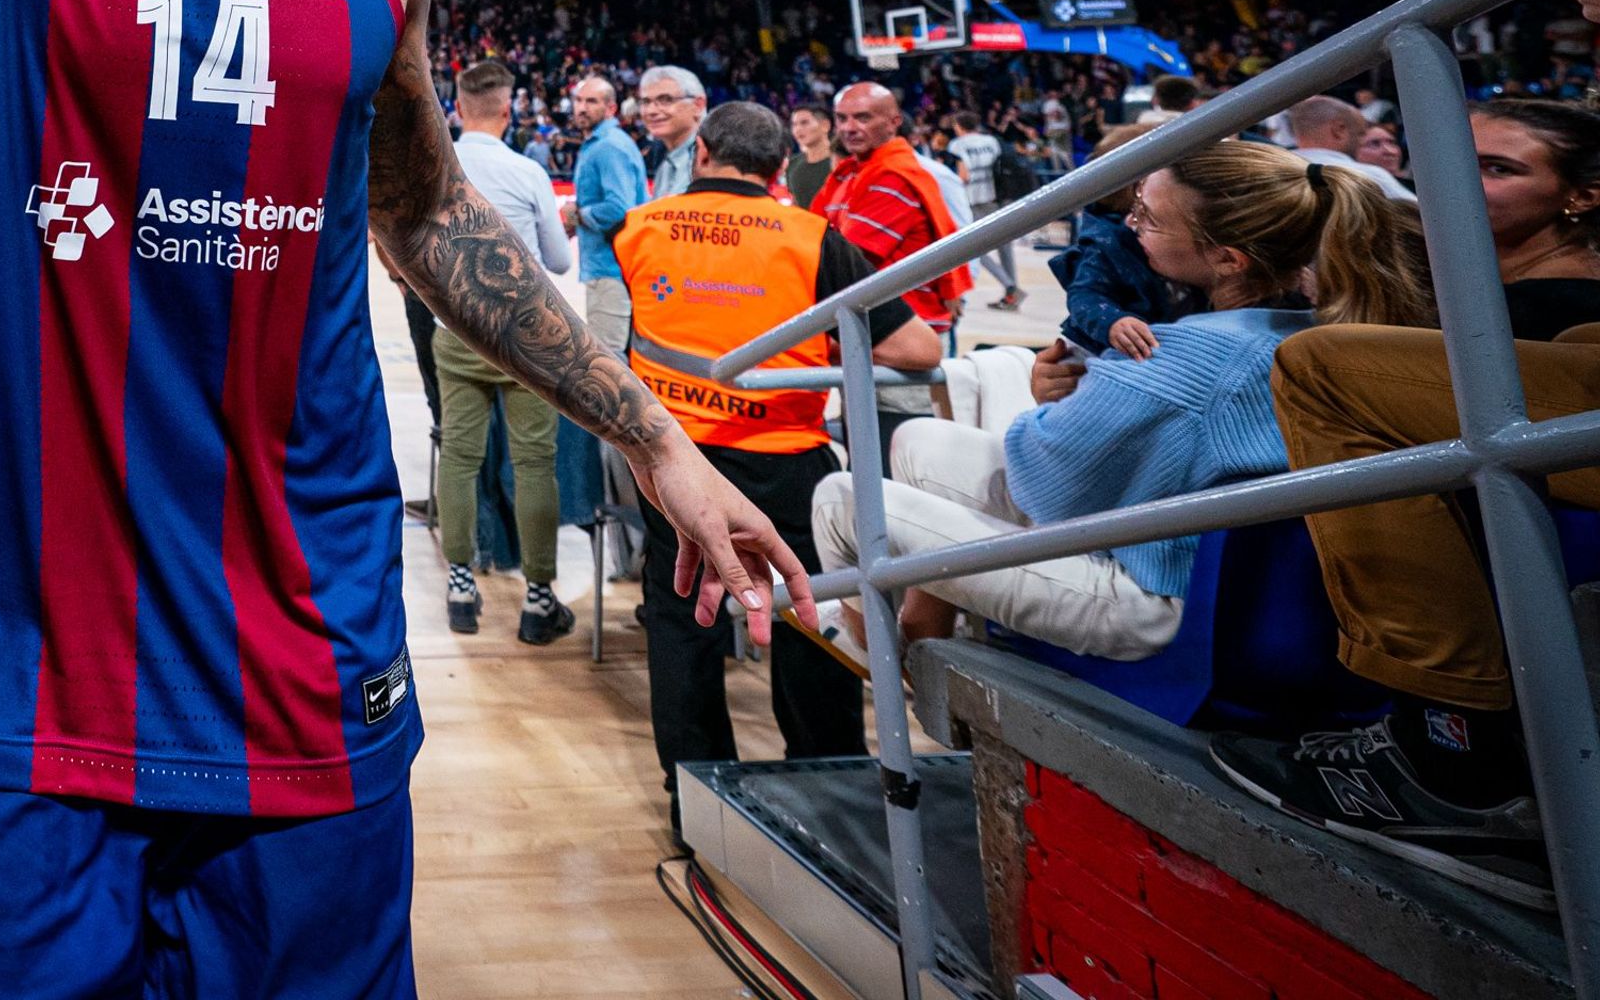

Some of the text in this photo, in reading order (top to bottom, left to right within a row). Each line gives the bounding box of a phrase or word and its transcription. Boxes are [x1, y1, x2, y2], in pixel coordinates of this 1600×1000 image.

[136, 225, 280, 271] Sanitària
[670, 223, 741, 247] STW-680
[642, 375, 768, 420] STEWARD
